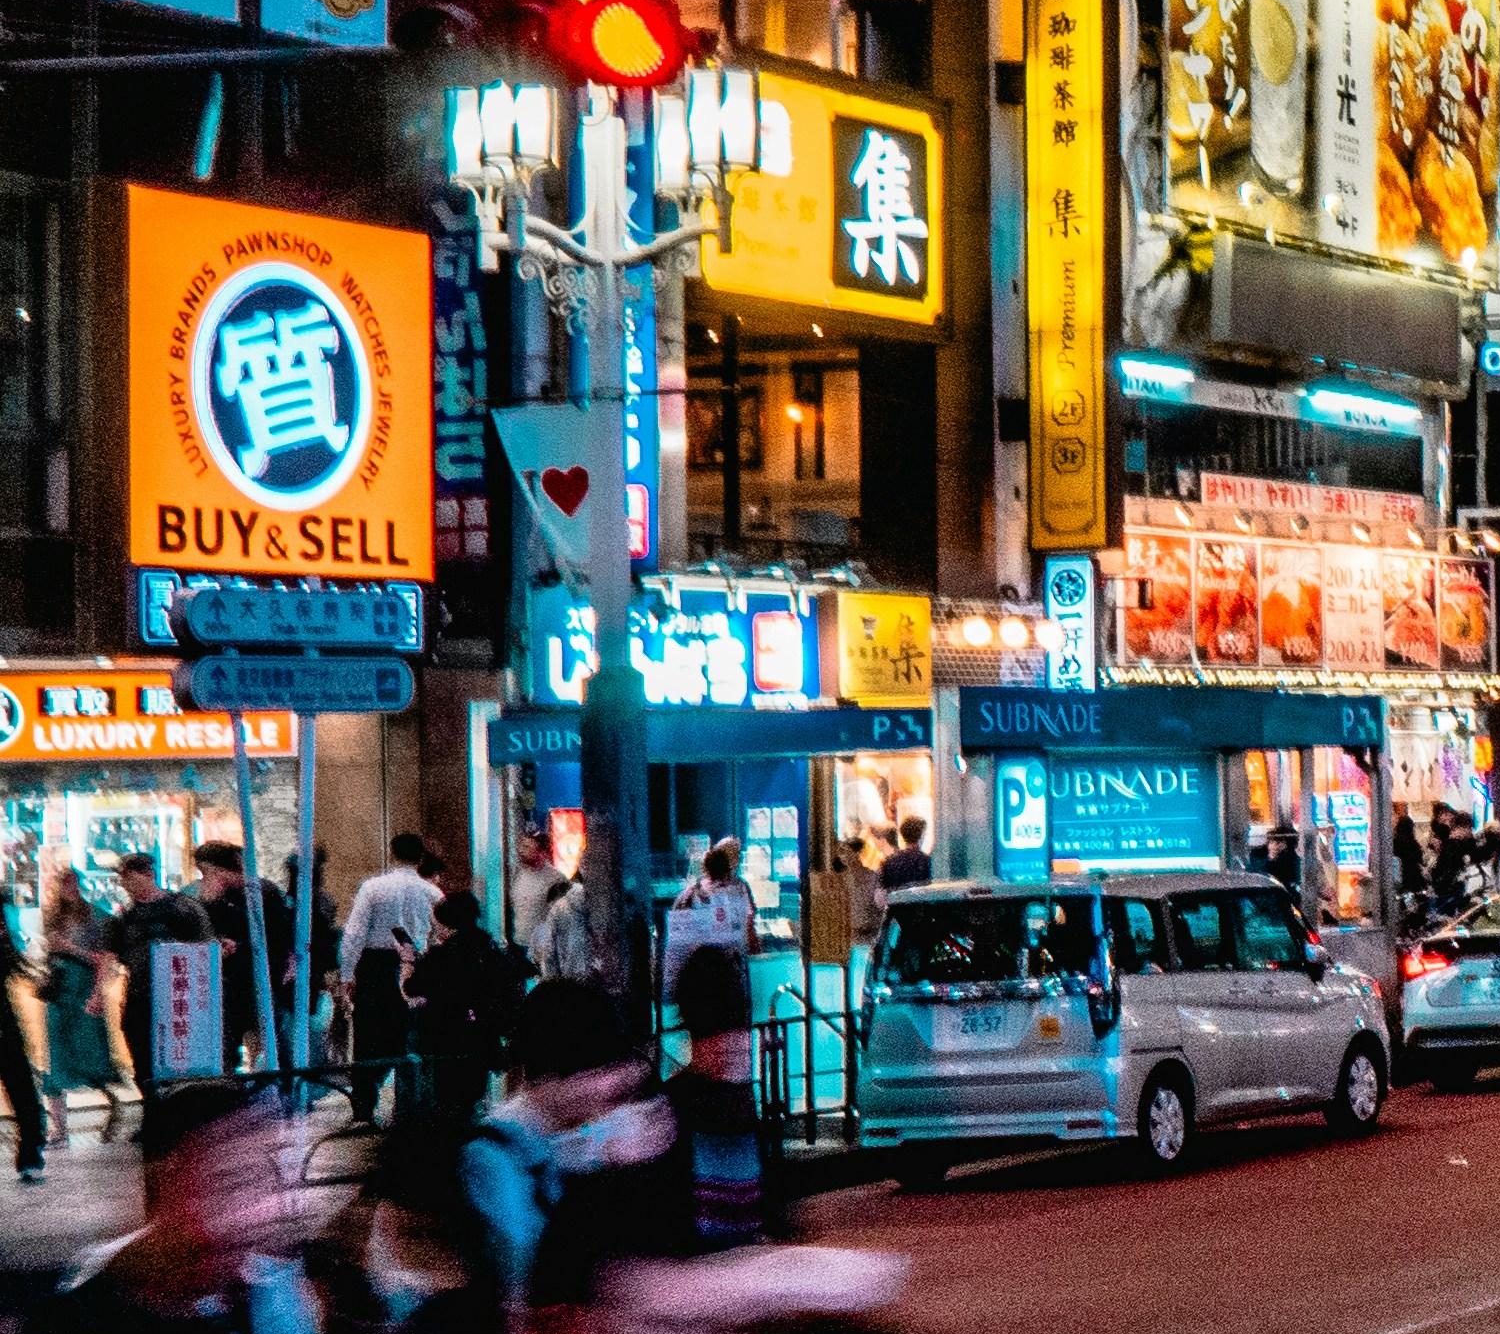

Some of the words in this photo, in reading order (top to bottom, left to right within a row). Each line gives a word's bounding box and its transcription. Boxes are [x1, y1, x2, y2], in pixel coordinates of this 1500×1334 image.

[1048, 11, 1079, 149] 珈琲茶館
[1335, 74, 1358, 127] 光
[842, 128, 929, 286] 集
[1043, 188, 1087, 240] 集
[222, 231, 333, 268] PAWNSHOP
[170, 262, 217, 361] BRANDS
[1057, 259, 1077, 374] Premium
[217, 299, 350, 479] 質
[1056, 399, 1082, 422] 2F
[168, 374, 208, 479] LUXURY
[1326, 592, 1381, 614] ミニカレー
[33, 722, 157, 752] LUXURY
[980, 700, 1101, 738] SUBNADE
[1003, 777, 1026, 842] P
[1051, 766, 1199, 801] UBNADE
